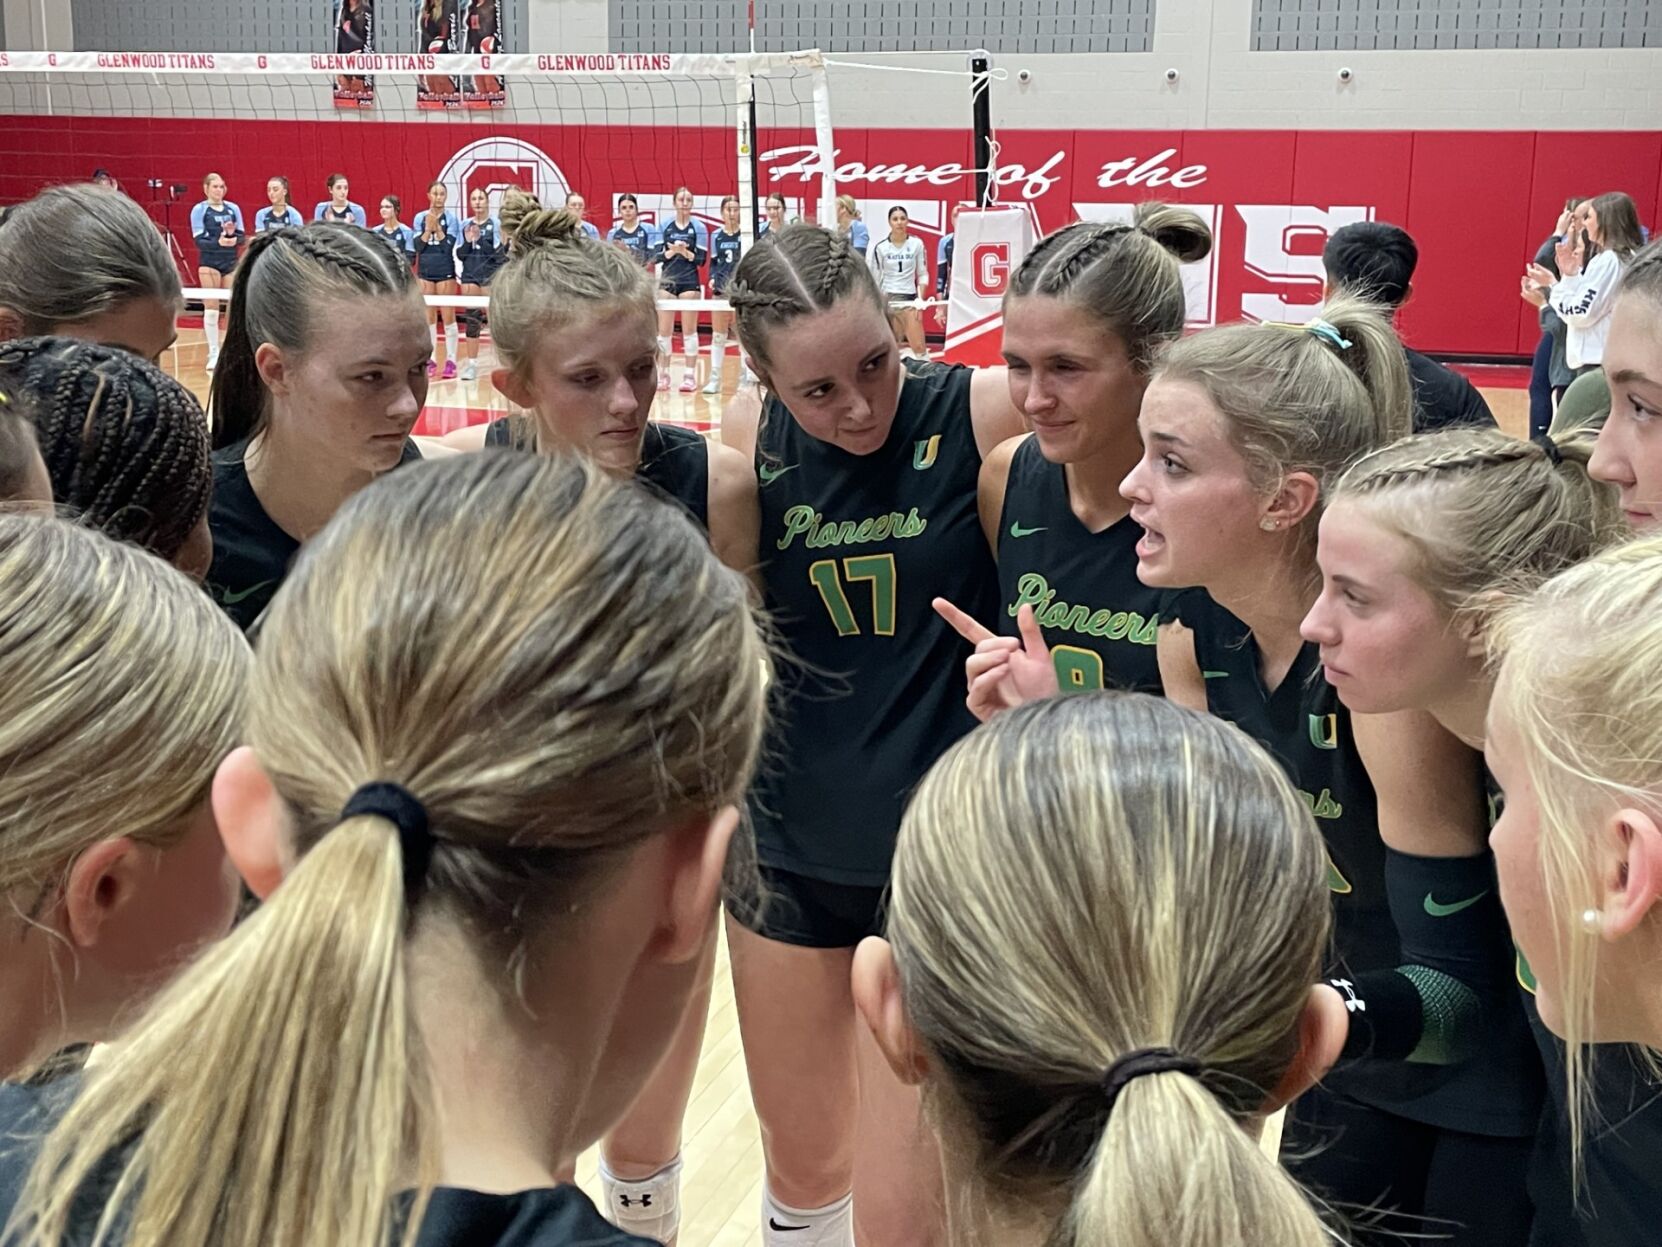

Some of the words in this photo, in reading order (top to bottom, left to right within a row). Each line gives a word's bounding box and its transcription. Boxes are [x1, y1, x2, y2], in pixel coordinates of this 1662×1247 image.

[48, 53, 57, 66] G
[97, 53, 166, 68] GLENWOOD
[168, 54, 215, 69] TITANS
[257, 55, 267, 69] G
[311, 54, 382, 70] GLENWOOD
[385, 55, 435, 70] TITANS
[481, 55, 490, 70] G
[538, 54, 615, 70] GLENWOOD
[618, 54, 671, 70] TITANS
[759, 144, 962, 185] Home
[993, 151, 1065, 199] of
[1097, 148, 1207, 188] the
[725, 249, 733, 263] 3
[898, 261, 903, 273] 1
[971, 242, 1010, 298] G
[913, 434, 943, 470] U
[776, 504, 928, 550] Pioneers
[809, 553, 897, 637] 17
[1008, 572, 1160, 645] Pioneers
[1309, 713, 1337, 750] U
